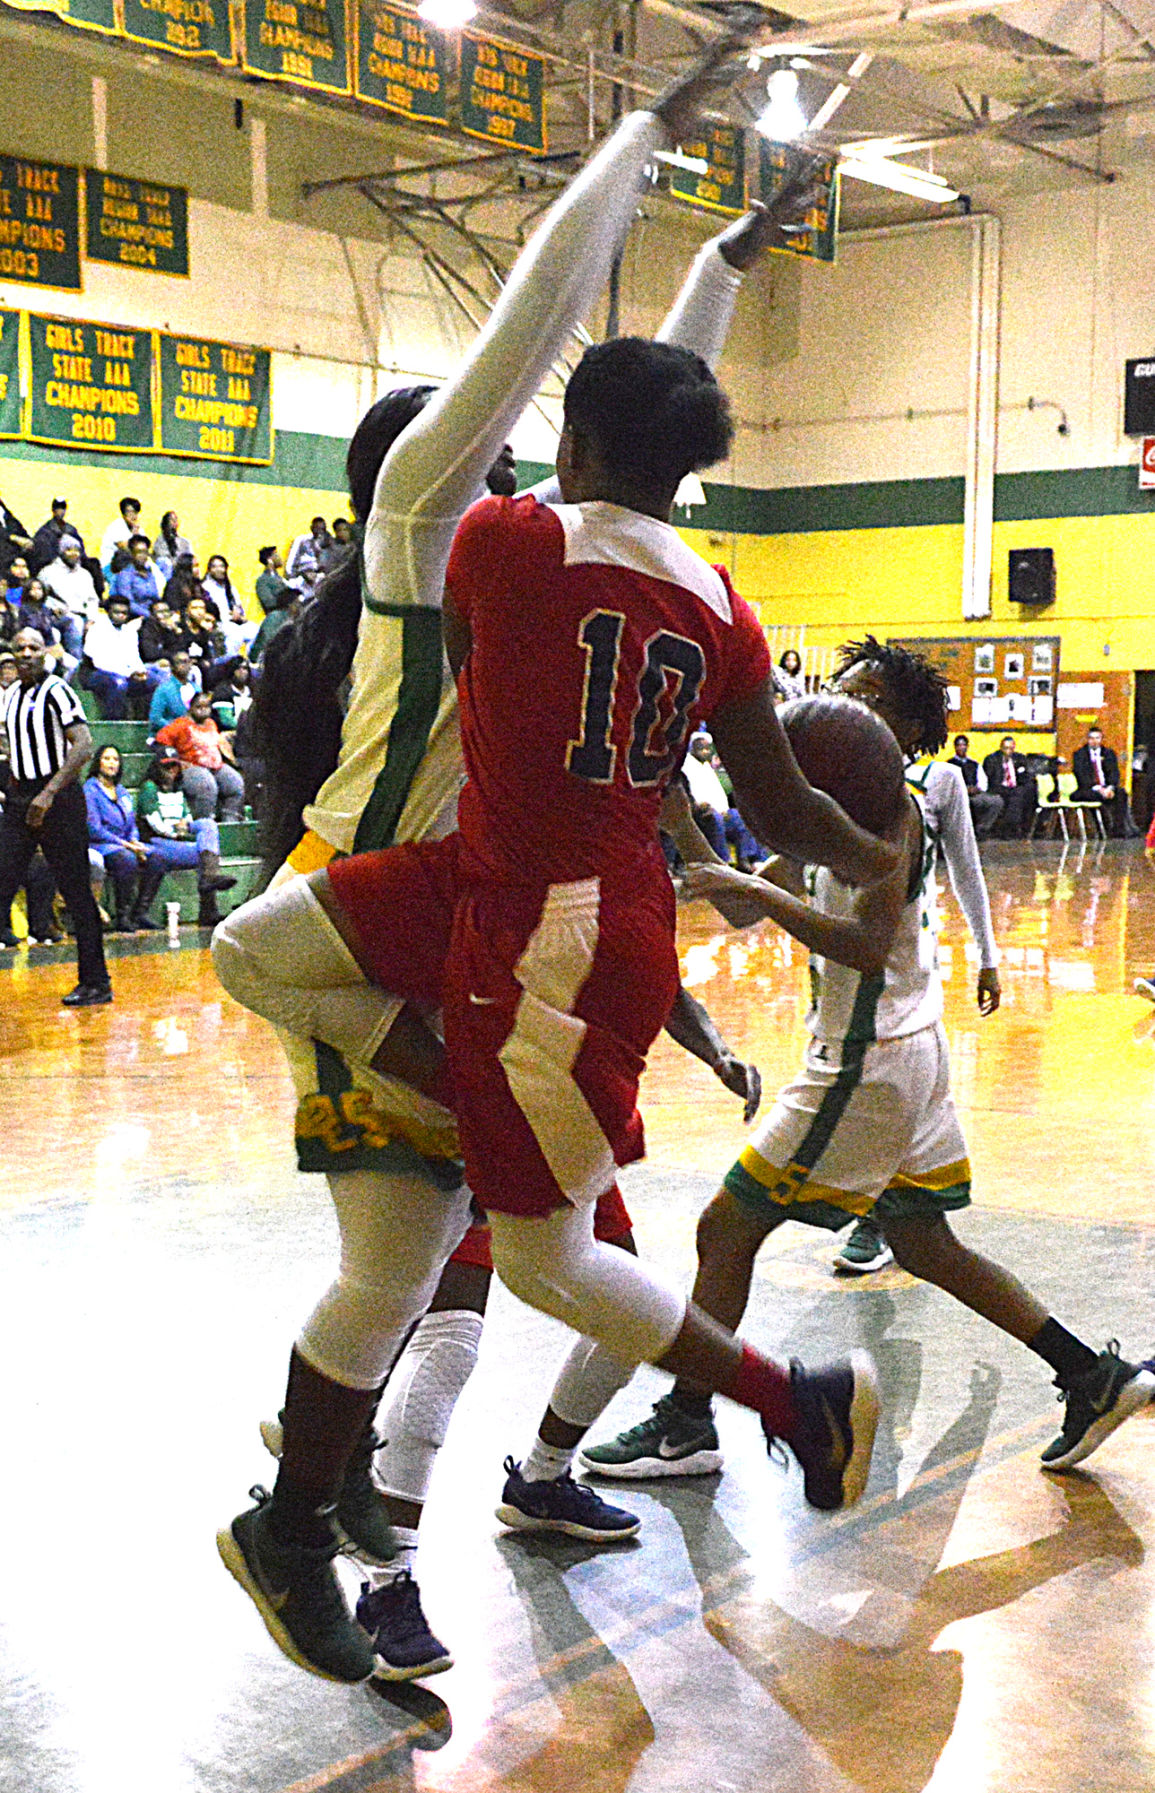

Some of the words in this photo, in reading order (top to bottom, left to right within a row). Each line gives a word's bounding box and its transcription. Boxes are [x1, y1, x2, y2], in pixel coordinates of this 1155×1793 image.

[367, 52, 440, 94] CHAMPIONS
[16, 161, 61, 194] TRACK
[26, 193, 52, 222] AAA
[100, 217, 174, 249] CHAMPIONS
[45, 324, 84, 353] GIRLS
[94, 330, 135, 359] TRACK
[52, 353, 94, 383] STATE
[104, 361, 131, 387] AAA
[176, 342, 211, 369] GIRLS
[220, 348, 256, 375] TRACK
[45, 380, 140, 416] CHAMPIONS
[181, 369, 217, 397] STATE
[227, 376, 251, 401] AAA
[71, 412, 116, 441] 2010
[174, 395, 258, 429] CHAMPIONS
[198, 425, 235, 453] 2011
[564, 607, 706, 788] 10
